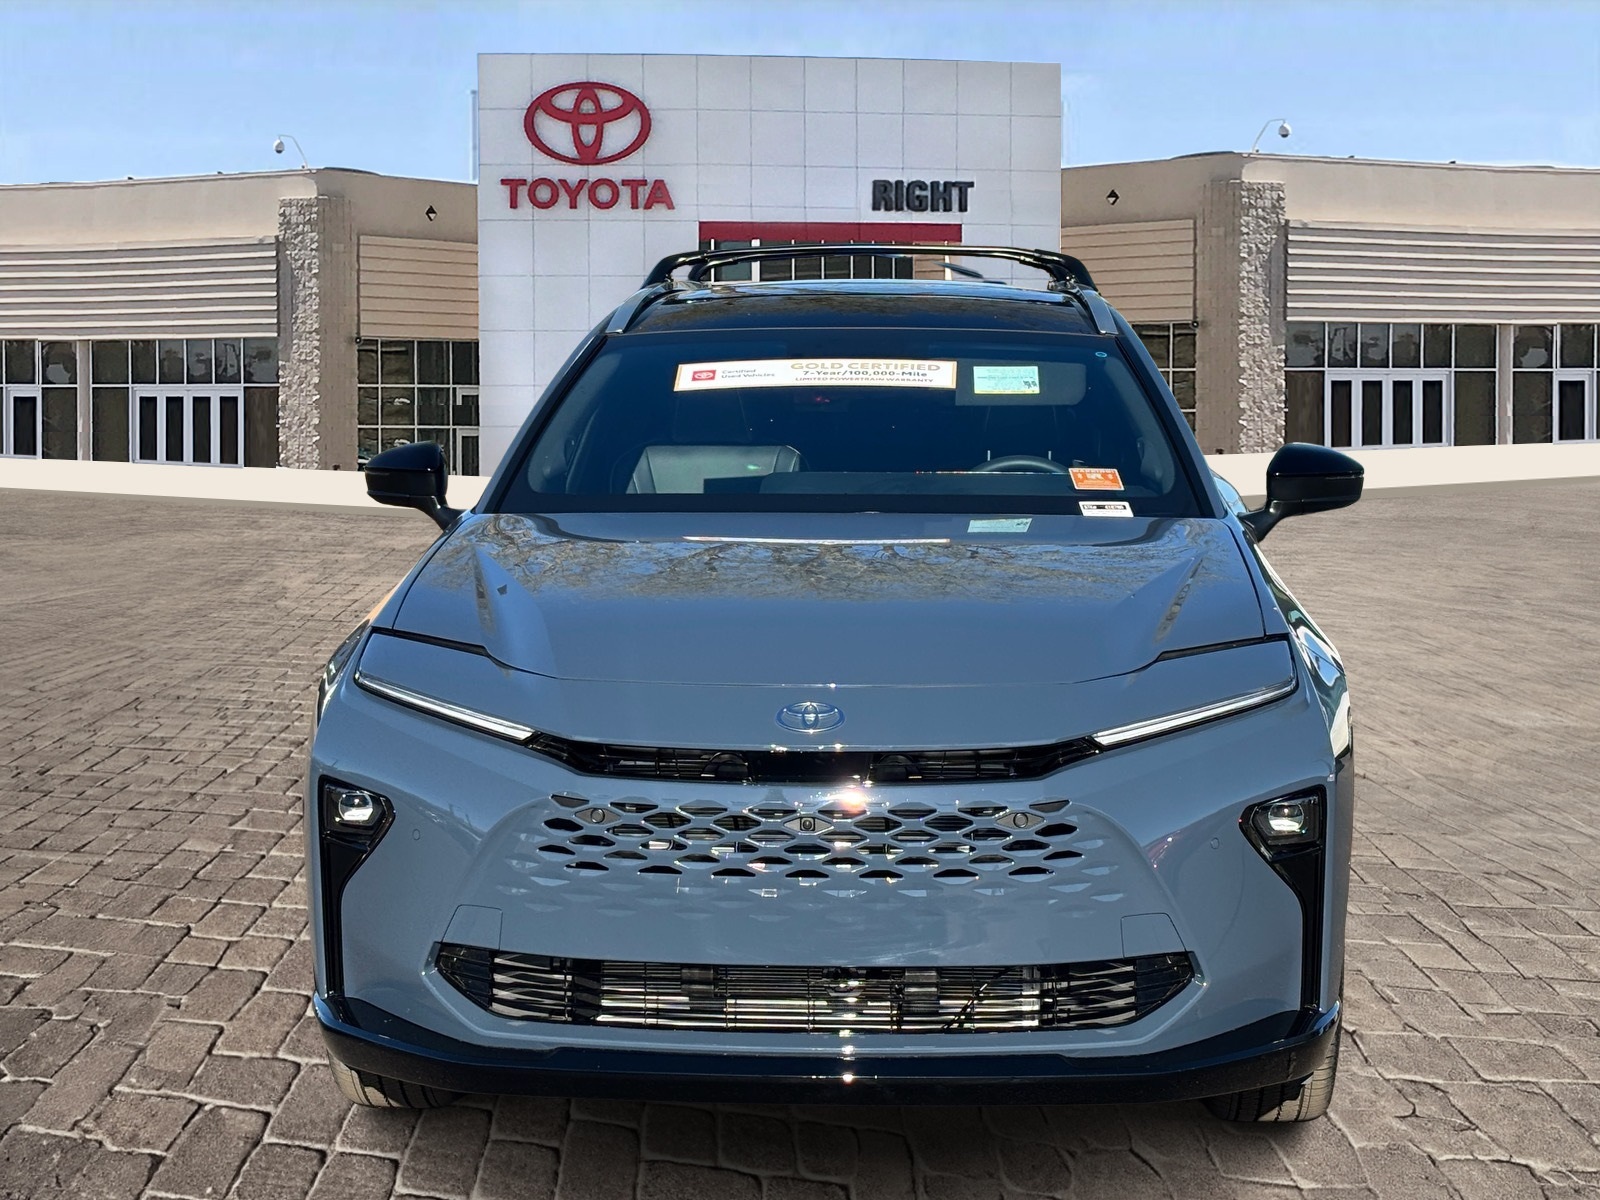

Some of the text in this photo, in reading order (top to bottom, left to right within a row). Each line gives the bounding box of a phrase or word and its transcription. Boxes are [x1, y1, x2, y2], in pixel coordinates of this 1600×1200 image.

[501, 178, 675, 210] TOYOTA
[871, 180, 975, 213] RIGHT
[790, 362, 941, 371] GOLD CERTIFIED
